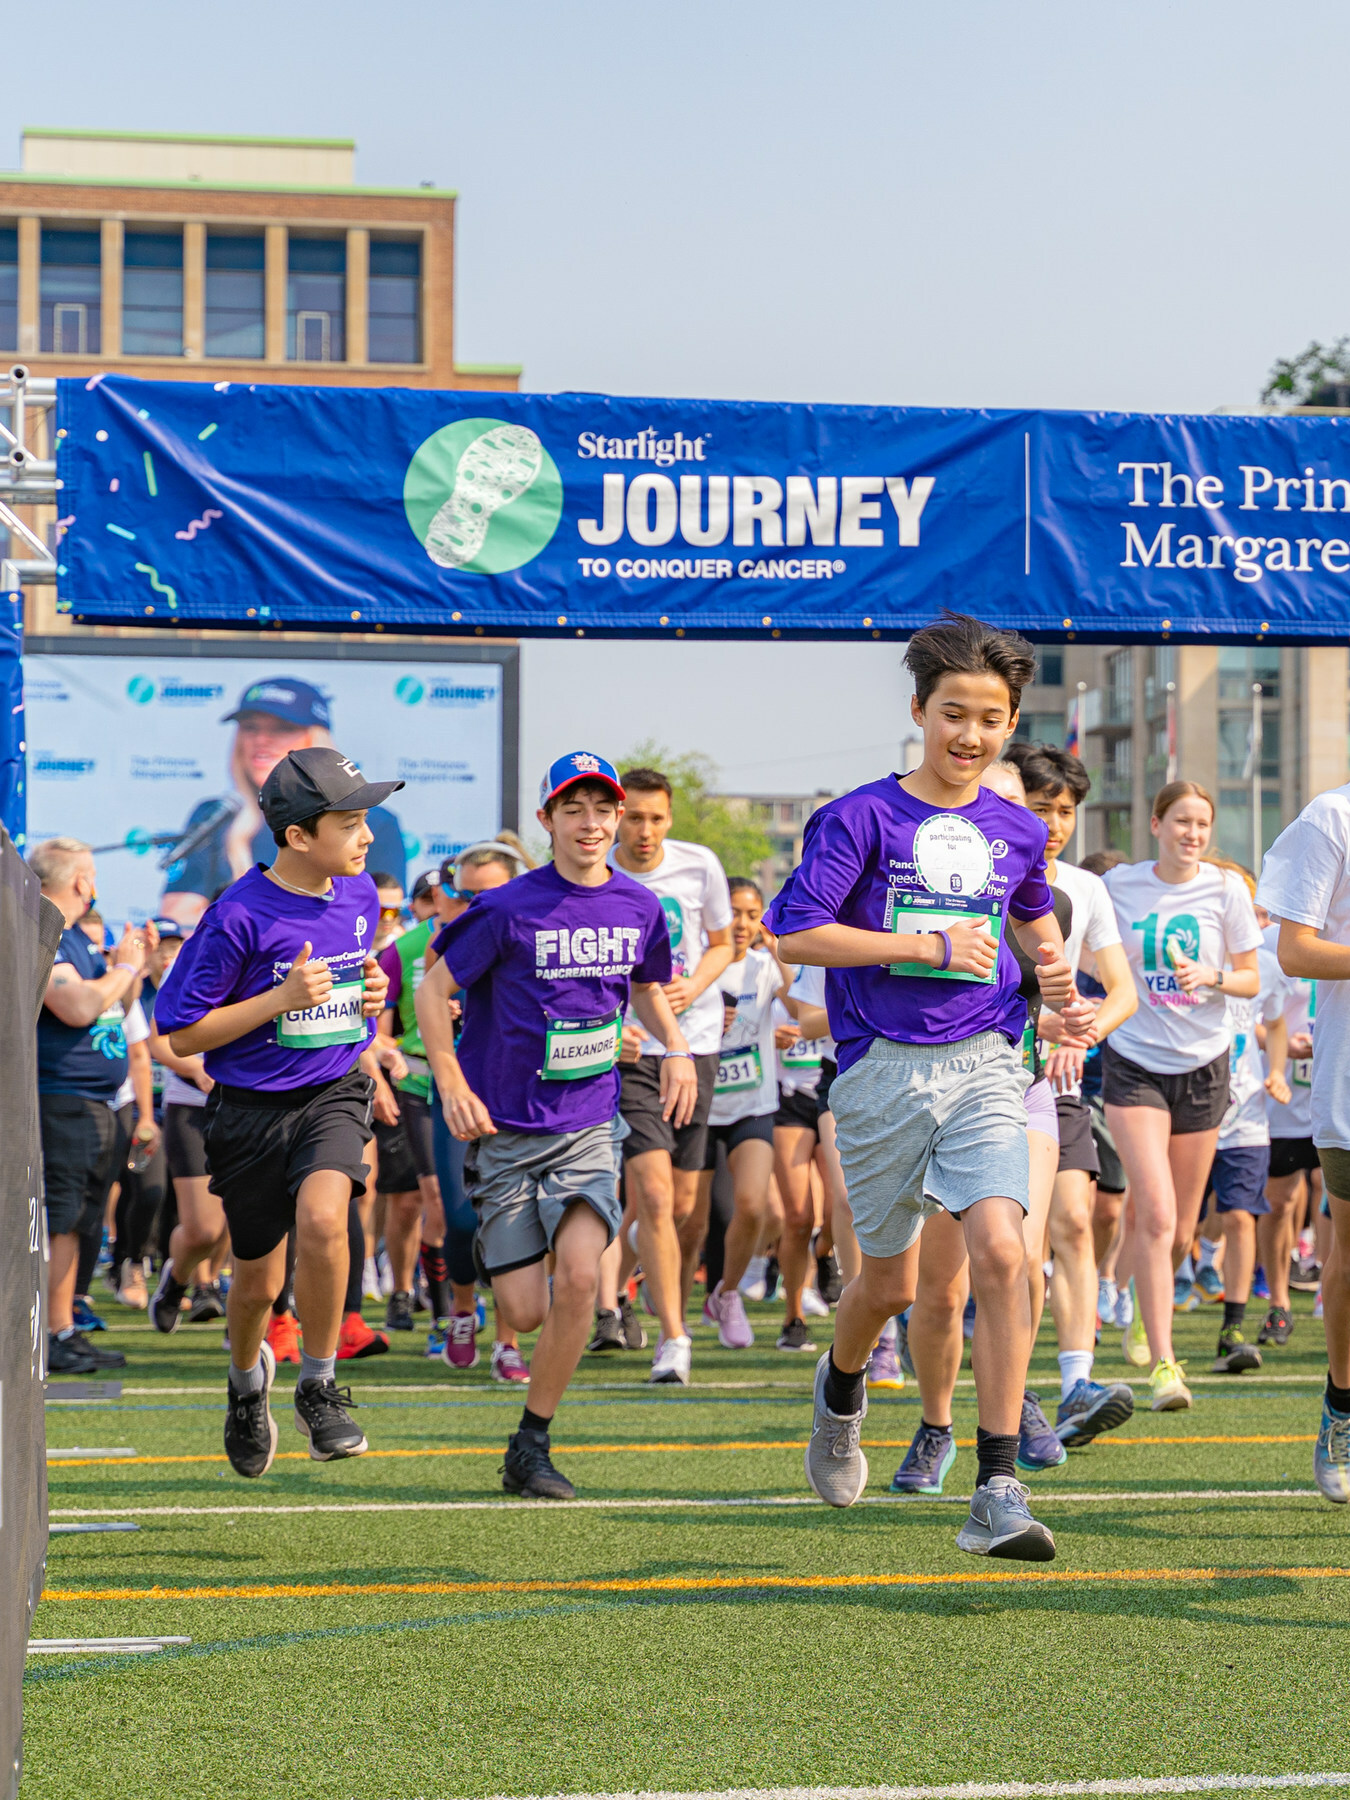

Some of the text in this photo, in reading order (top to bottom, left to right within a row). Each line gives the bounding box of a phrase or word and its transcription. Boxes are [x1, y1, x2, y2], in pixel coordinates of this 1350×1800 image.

[1118, 462, 1225, 508] The
[578, 473, 936, 547] JOURNEY
[578, 558, 611, 578] TO
[615, 558, 732, 579] CONQUER
[535, 927, 641, 967] FIGHT
[535, 966, 603, 980] PANCREATIC
[1145, 976, 1178, 992] YEA
[286, 1000, 361, 1022] GRAHAM
[552, 1037, 614, 1060] ALEXANDRE
